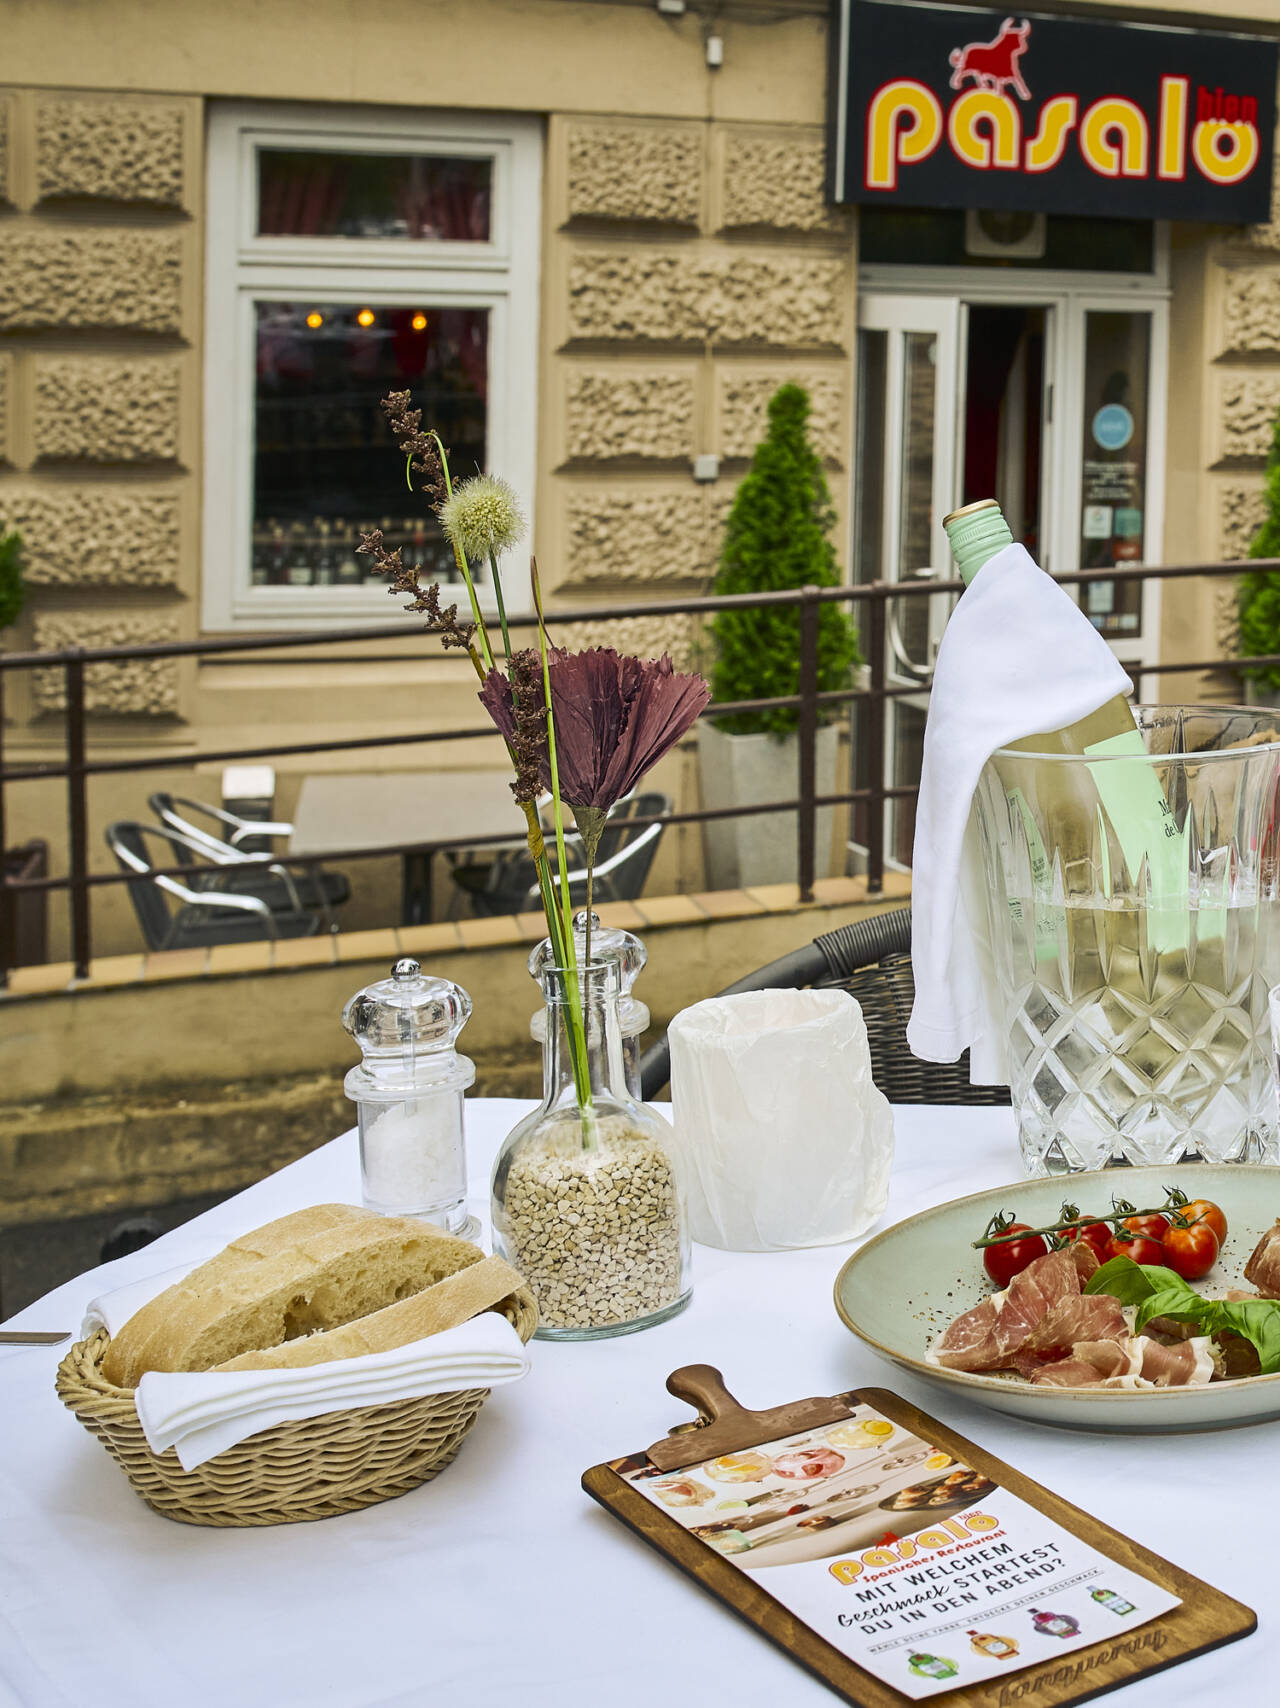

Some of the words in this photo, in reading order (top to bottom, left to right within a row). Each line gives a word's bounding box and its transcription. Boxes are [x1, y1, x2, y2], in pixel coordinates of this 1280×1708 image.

[864, 74, 1261, 191] pasalo
[828, 1515, 999, 1586] pasalo
[855, 1581, 897, 1603] MIT
[904, 1543, 1014, 1587] WELCHEM
[937, 1529, 1007, 1557] Restaurant
[837, 1584, 950, 1627] Geschmack
[953, 1543, 1061, 1589] STARTEST
[860, 1619, 893, 1634] DU
[899, 1609, 927, 1623] IN
[932, 1592, 978, 1613] DEN
[985, 1558, 1066, 1596] ABEND?
